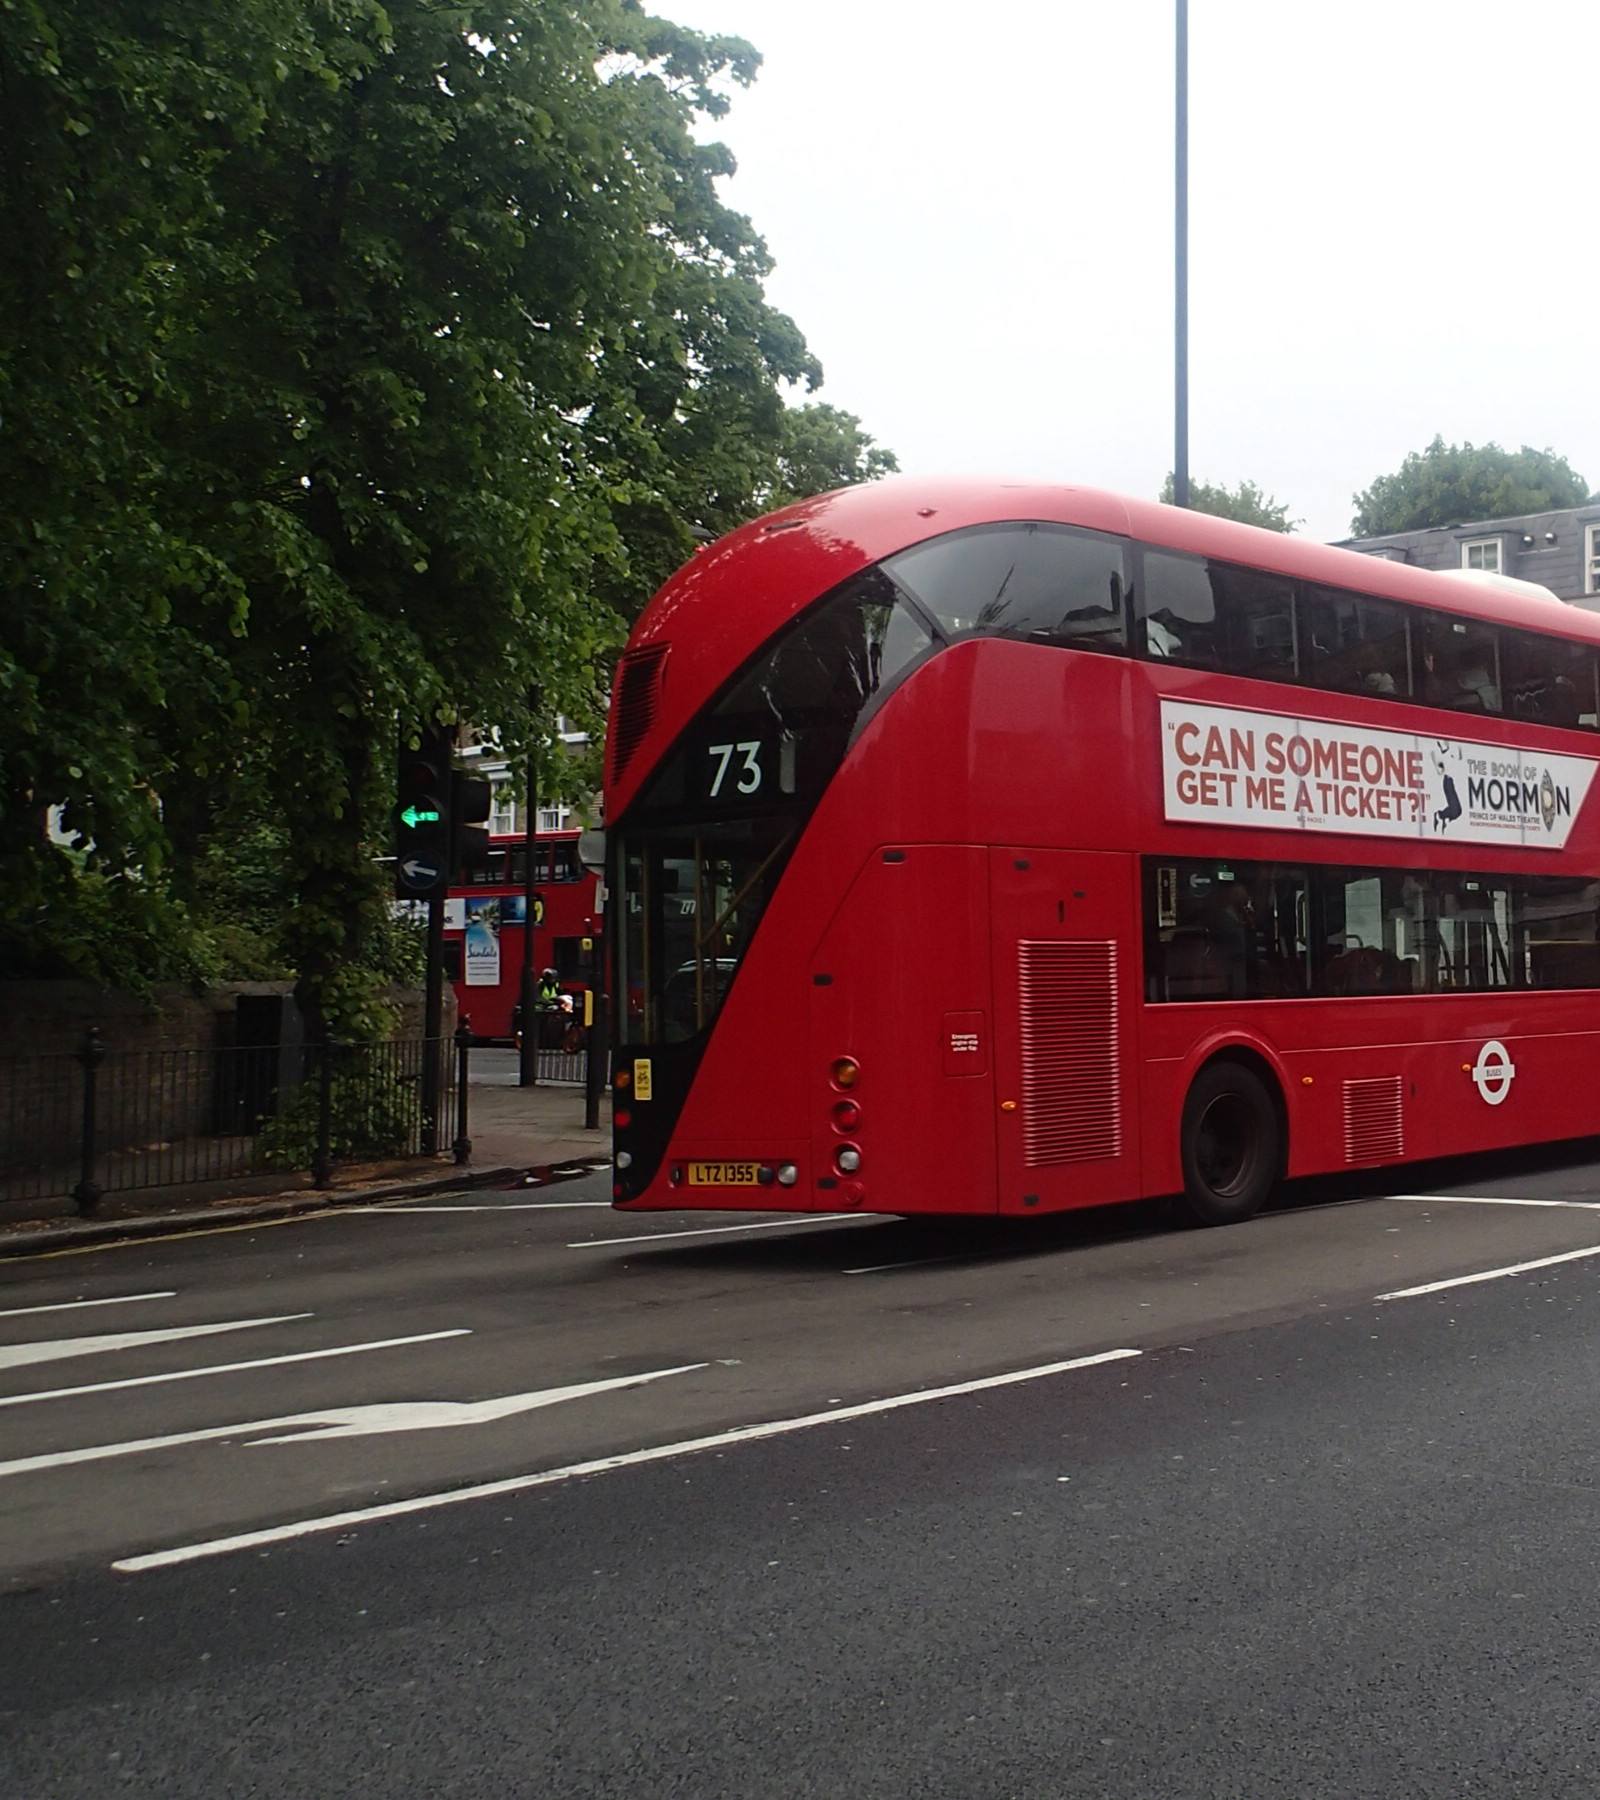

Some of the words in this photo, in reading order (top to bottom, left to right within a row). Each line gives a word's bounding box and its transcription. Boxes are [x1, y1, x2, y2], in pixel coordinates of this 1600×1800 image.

[708, 740, 762, 797] 73
[1265, 732, 1425, 789] SOMEONE
[1467, 759, 1487, 775] THE
[1491, 762, 1520, 780] BOOK
[1523, 766, 1538, 781] OF
[1176, 769, 1238, 808] GET
[1245, 775, 1287, 811] ME
[1293, 780, 1315, 814] A
[1467, 776, 1571, 817] MORMON
[1469, 811, 1488, 820] PRINCE
[696, 1165, 721, 1182] LTZ
[724, 1165, 754, 1182] 1355
